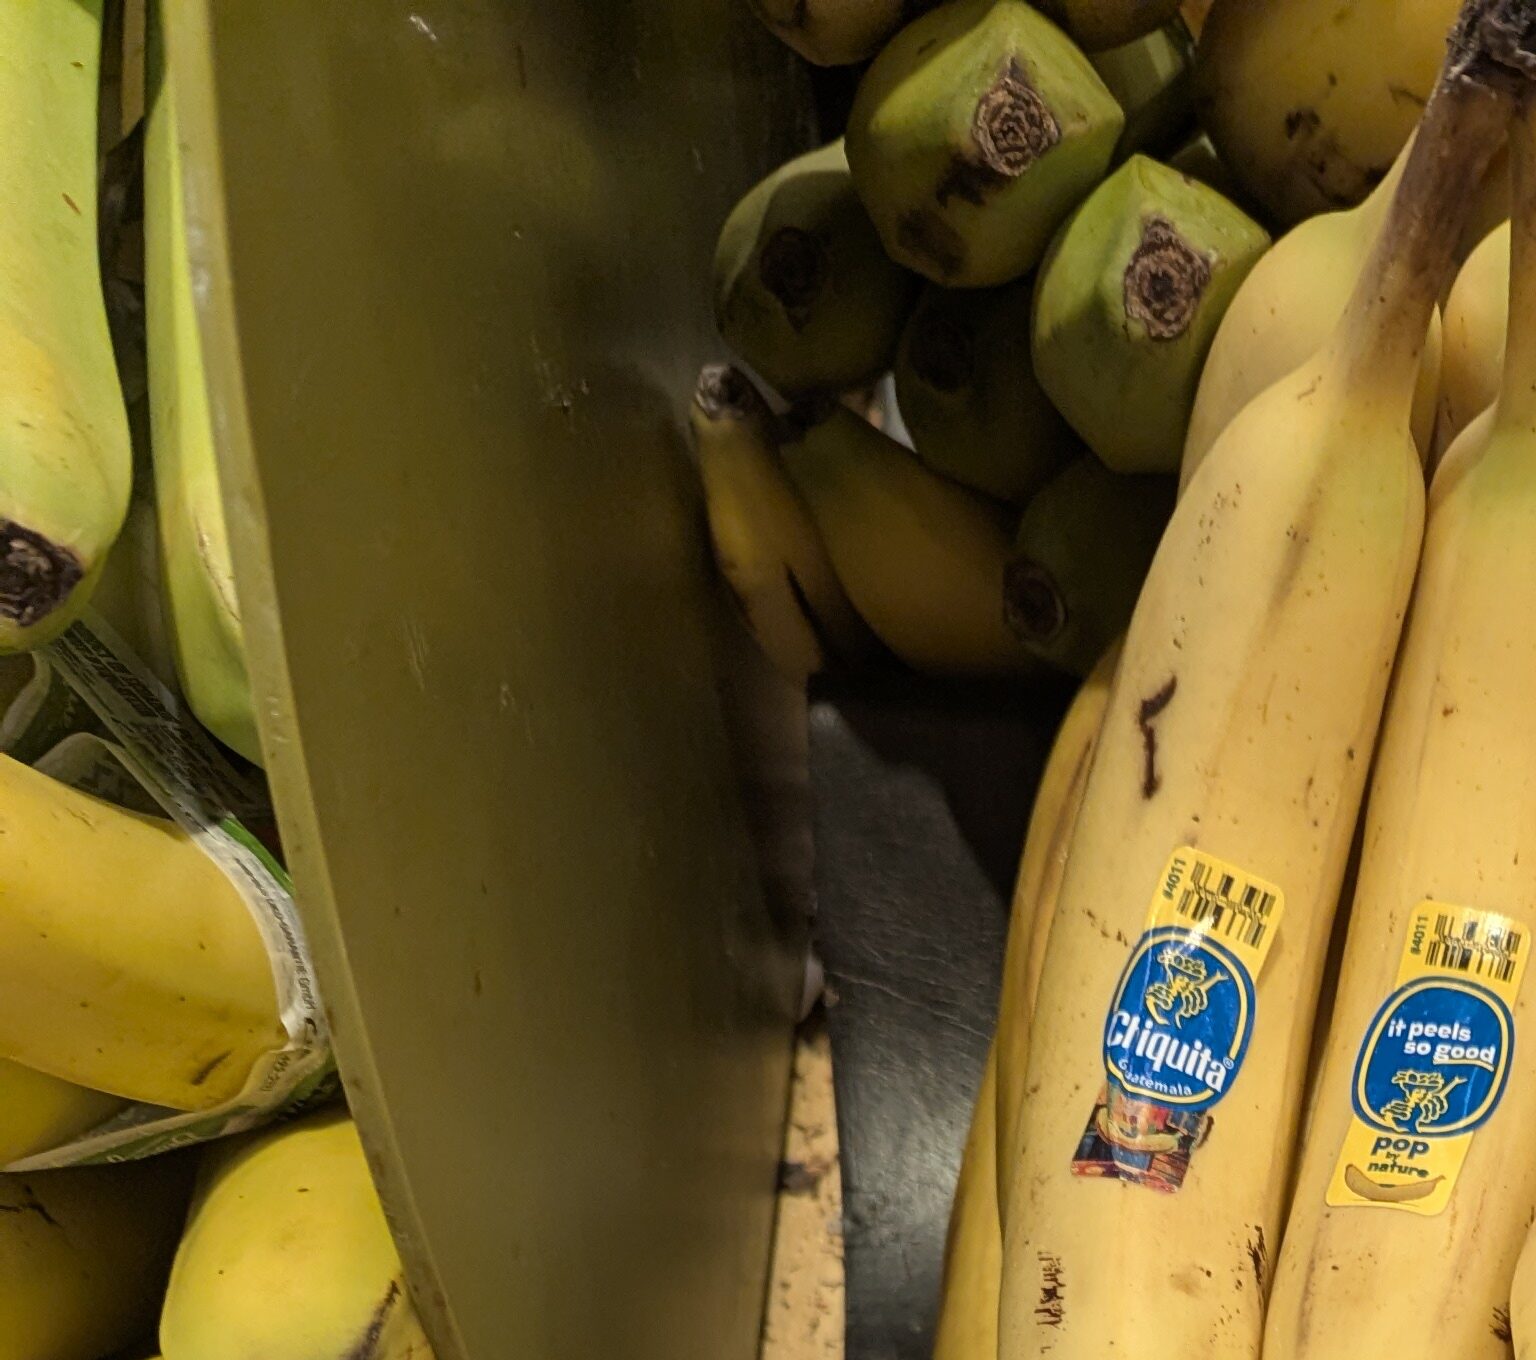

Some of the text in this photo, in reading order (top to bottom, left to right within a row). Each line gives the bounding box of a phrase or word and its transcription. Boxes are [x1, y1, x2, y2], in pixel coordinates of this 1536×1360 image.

[1162, 857, 1188, 900] #4011
[1410, 915, 1429, 955] #4011
[1388, 1018, 1471, 1042] it peels
[1403, 1041, 1497, 1066] so good
[1370, 1136, 1430, 1159] pop
[1367, 1160, 1430, 1178] nature
